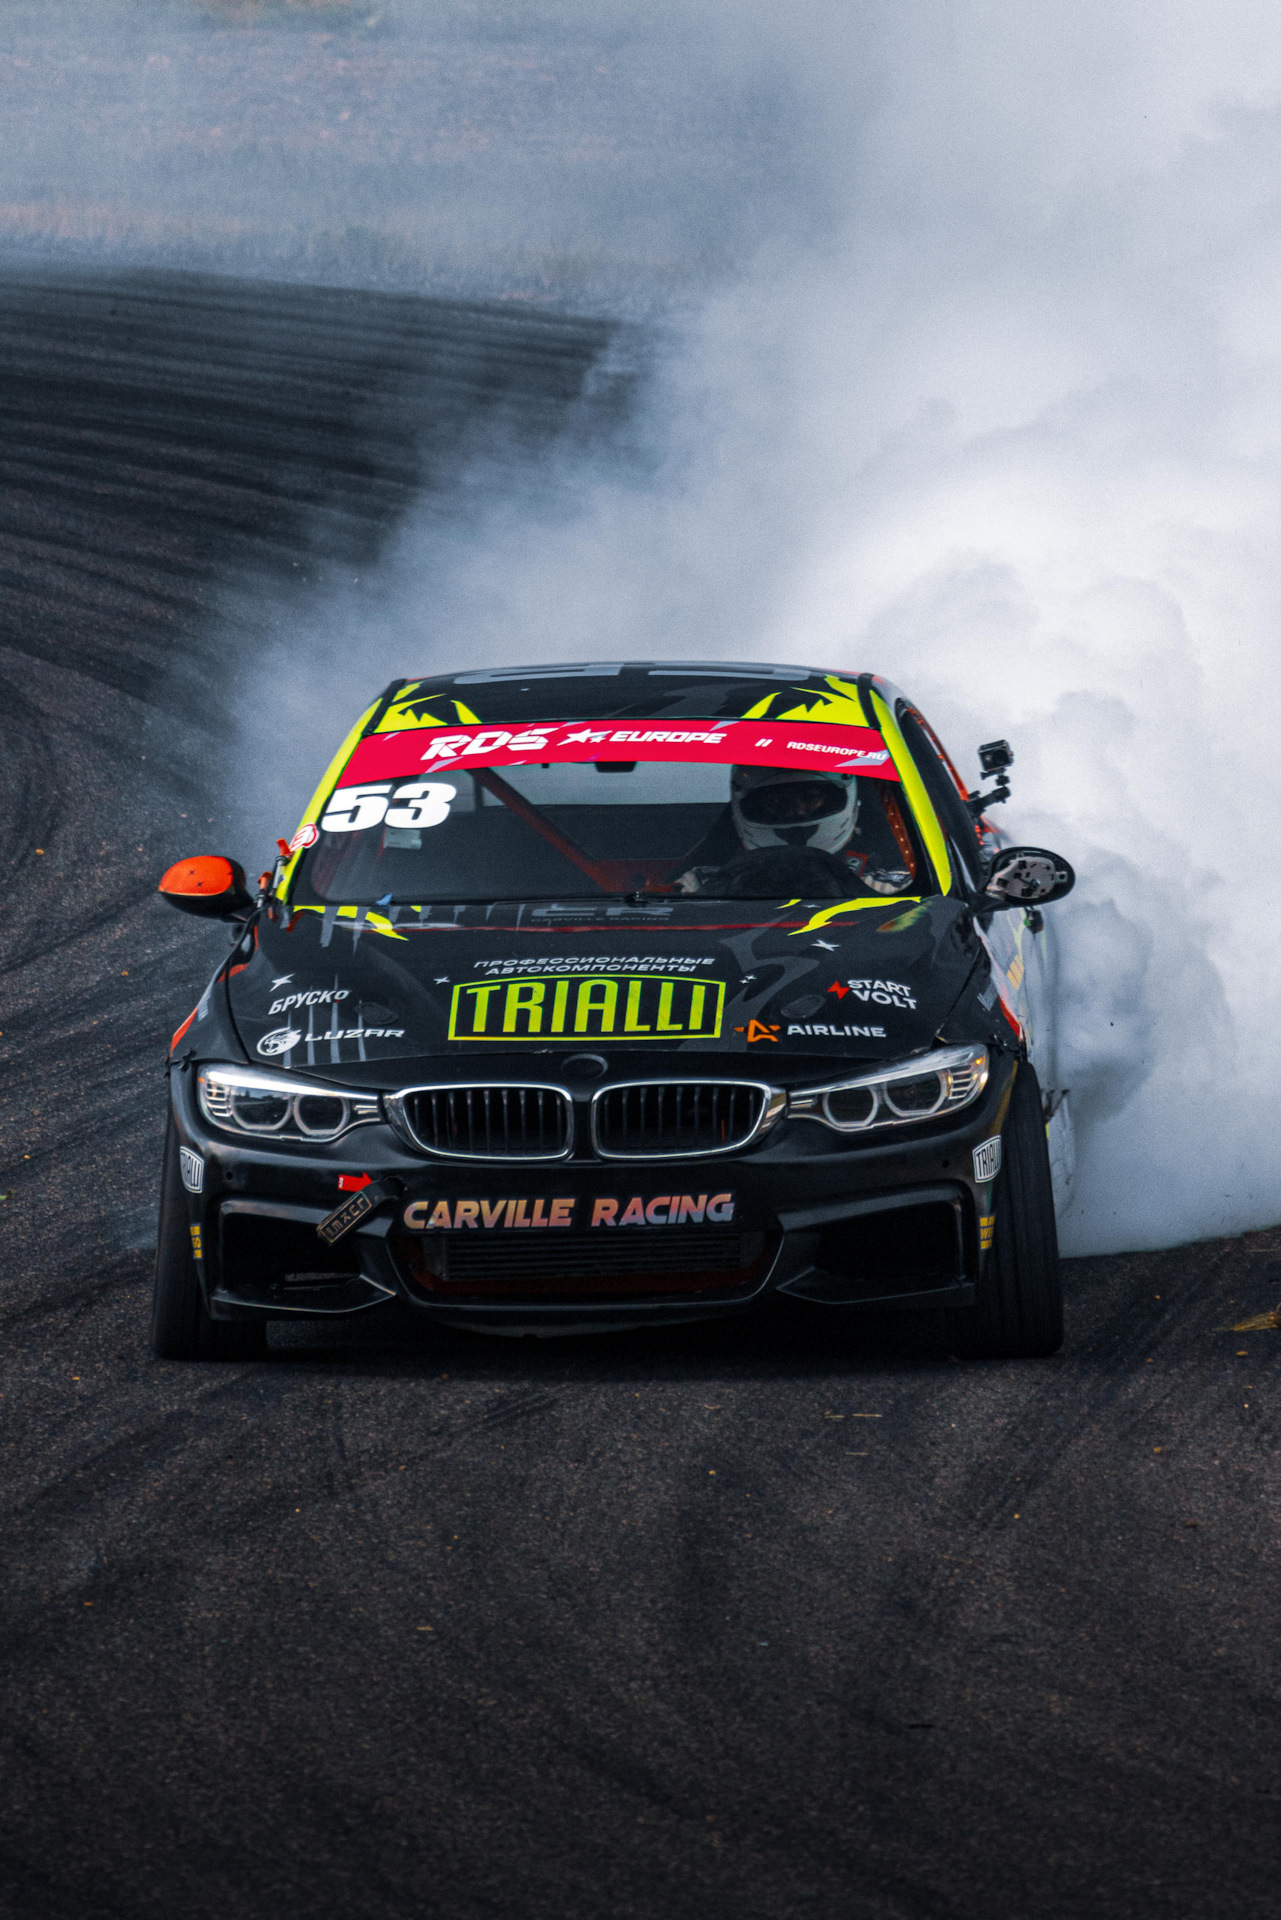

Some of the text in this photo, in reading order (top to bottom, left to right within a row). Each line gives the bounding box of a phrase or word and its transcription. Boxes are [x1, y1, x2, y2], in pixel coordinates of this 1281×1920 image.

[420, 728, 727, 760] RDS EUROPE
[787, 741, 887, 761] RDSEUROPE.RU
[321, 783, 456, 832] 53
[474, 956, 715, 968] ПРОФЕССИОНАЛЬНЫЕ
[485, 964, 696, 975] АВТОКОМПОНЕНТЫ
[847, 980, 911, 996] START
[466, 979, 706, 1032] TRIALLI
[852, 990, 917, 1010] VOLT
[305, 1029, 405, 1042] LUZAR
[787, 1025, 887, 1038] AIRLINE
[403, 1193, 735, 1229] CARVILLE RACING
